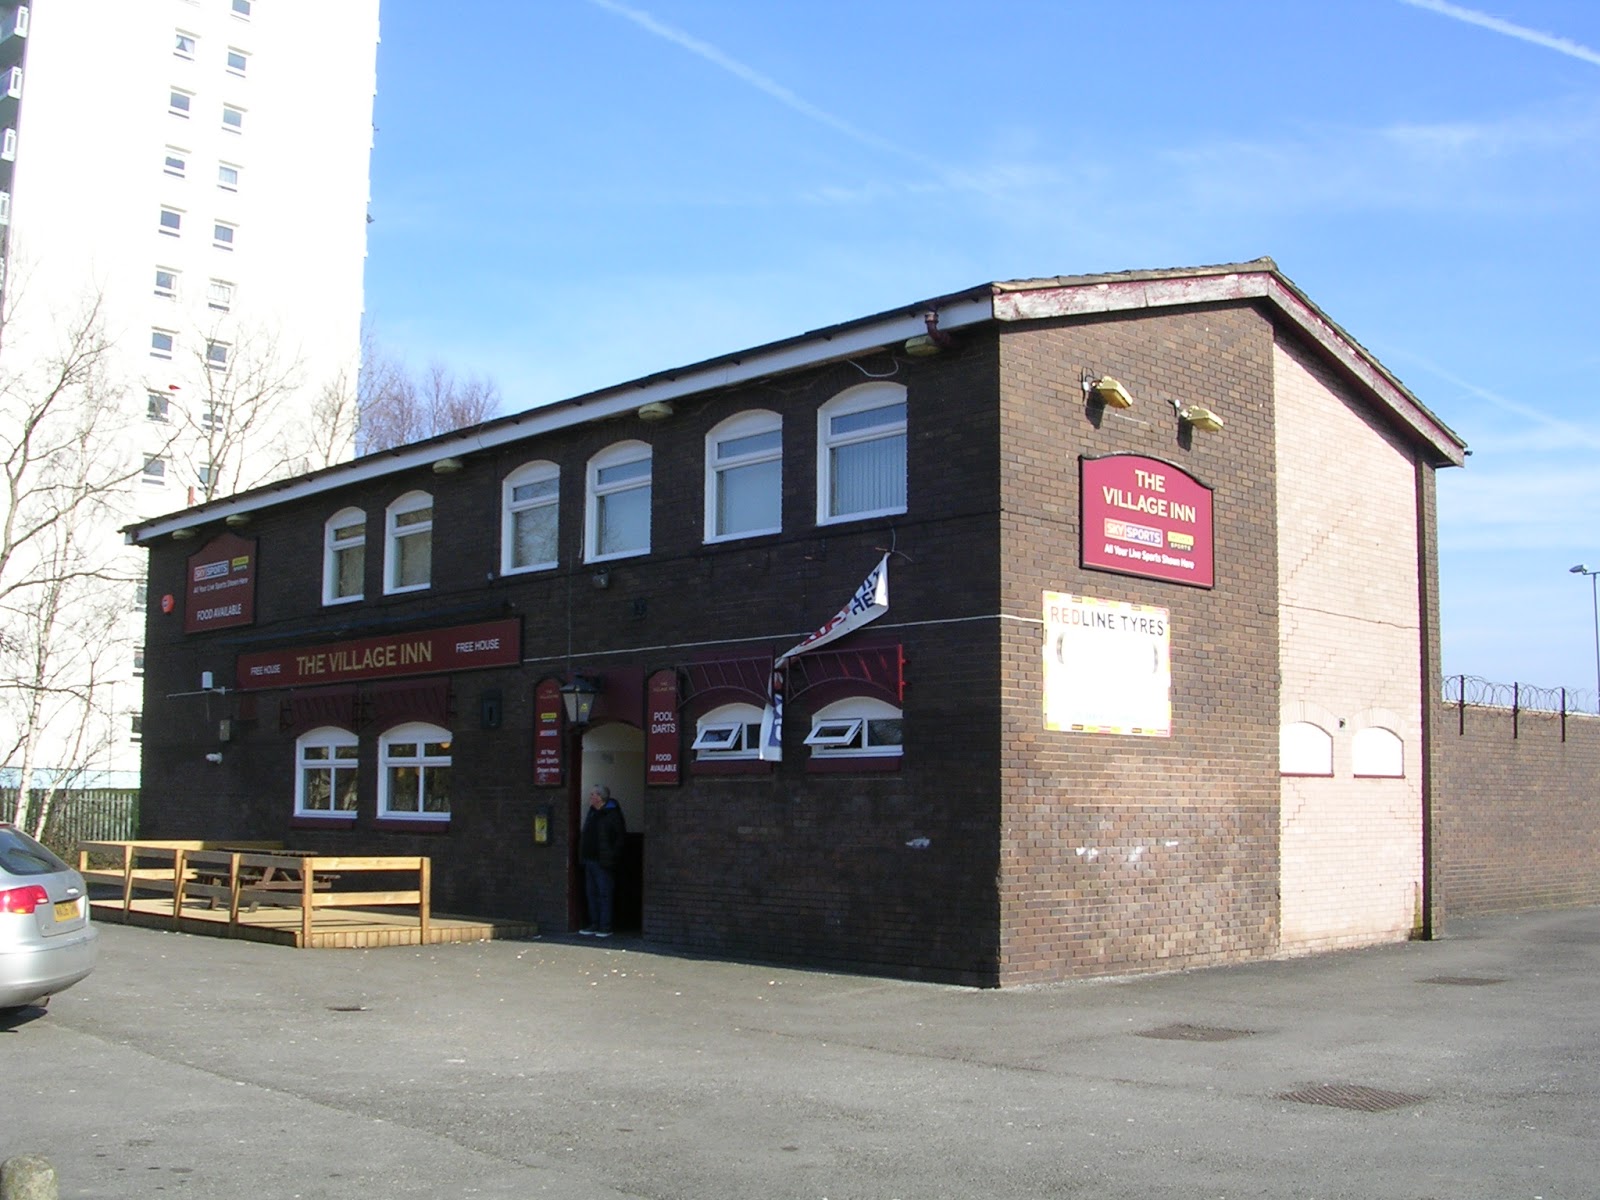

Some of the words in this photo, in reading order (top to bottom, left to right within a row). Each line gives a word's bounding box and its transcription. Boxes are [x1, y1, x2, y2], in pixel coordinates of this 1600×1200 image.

[1134, 469, 1166, 493] THE
[1102, 486, 1168, 517] VILLAGE
[1170, 501, 1196, 524] INN
[1106, 523, 1126, 539] SKY
[1126, 525, 1161, 543] SPORTS
[1104, 544, 1114, 554] All
[1114, 545, 1128, 557] Your
[1128, 548, 1141, 559] Live
[1141, 550, 1162, 563] Sports
[197, 608, 213, 621] FOOD
[213, 603, 242, 617] AVAILABLE
[1050, 606, 1115, 630] REDLINE
[1120, 615, 1164, 636] TYRES
[455, 640, 473, 654] FREE
[474, 638, 500, 652] HOUSE
[296, 654, 326, 676] THE
[329, 645, 396, 673] VILLAGE
[400, 641, 432, 664] INN
[250, 665, 264, 676] FREE
[264, 663, 281, 675] HOUSE
[653, 711, 674, 722] POOL
[651, 723, 676, 734] DARTS
[655, 753, 672, 762] FOOD
[650, 763, 677, 773] AVAILABLE
